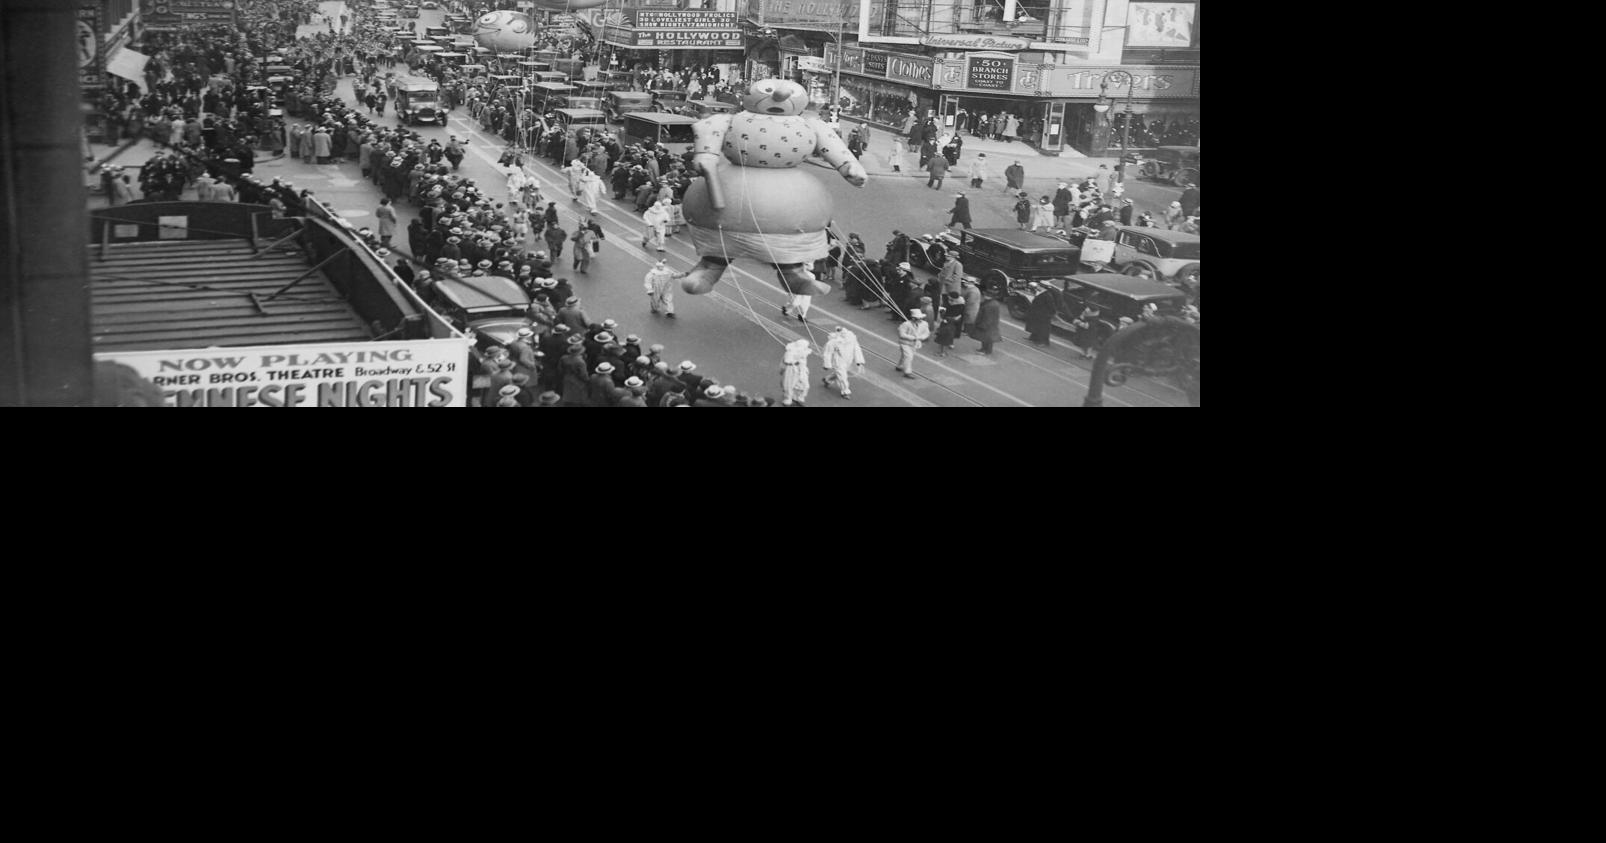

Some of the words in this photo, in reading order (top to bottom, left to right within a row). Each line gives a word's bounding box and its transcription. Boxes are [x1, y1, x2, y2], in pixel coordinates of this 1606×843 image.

[799, 1, 879, 18] HOLLYWOD
[655, 32, 740, 40] HOLLYWOOD
[925, 35, 979, 48] Universal
[892, 58, 931, 79] Clothes
[972, 66, 1009, 74] BRANCH
[1067, 70, 1175, 90] Trers
[159, 356, 246, 373] NOW
[260, 349, 414, 368] PLAYING
[153, 375, 200, 386] RNER
[209, 371, 261, 383] BROS.
[266, 367, 345, 381] THEATRE
[355, 366, 413, 377] Broadway
[163, 383, 307, 407] NNESE
[317, 376, 454, 407] NIGHTS
